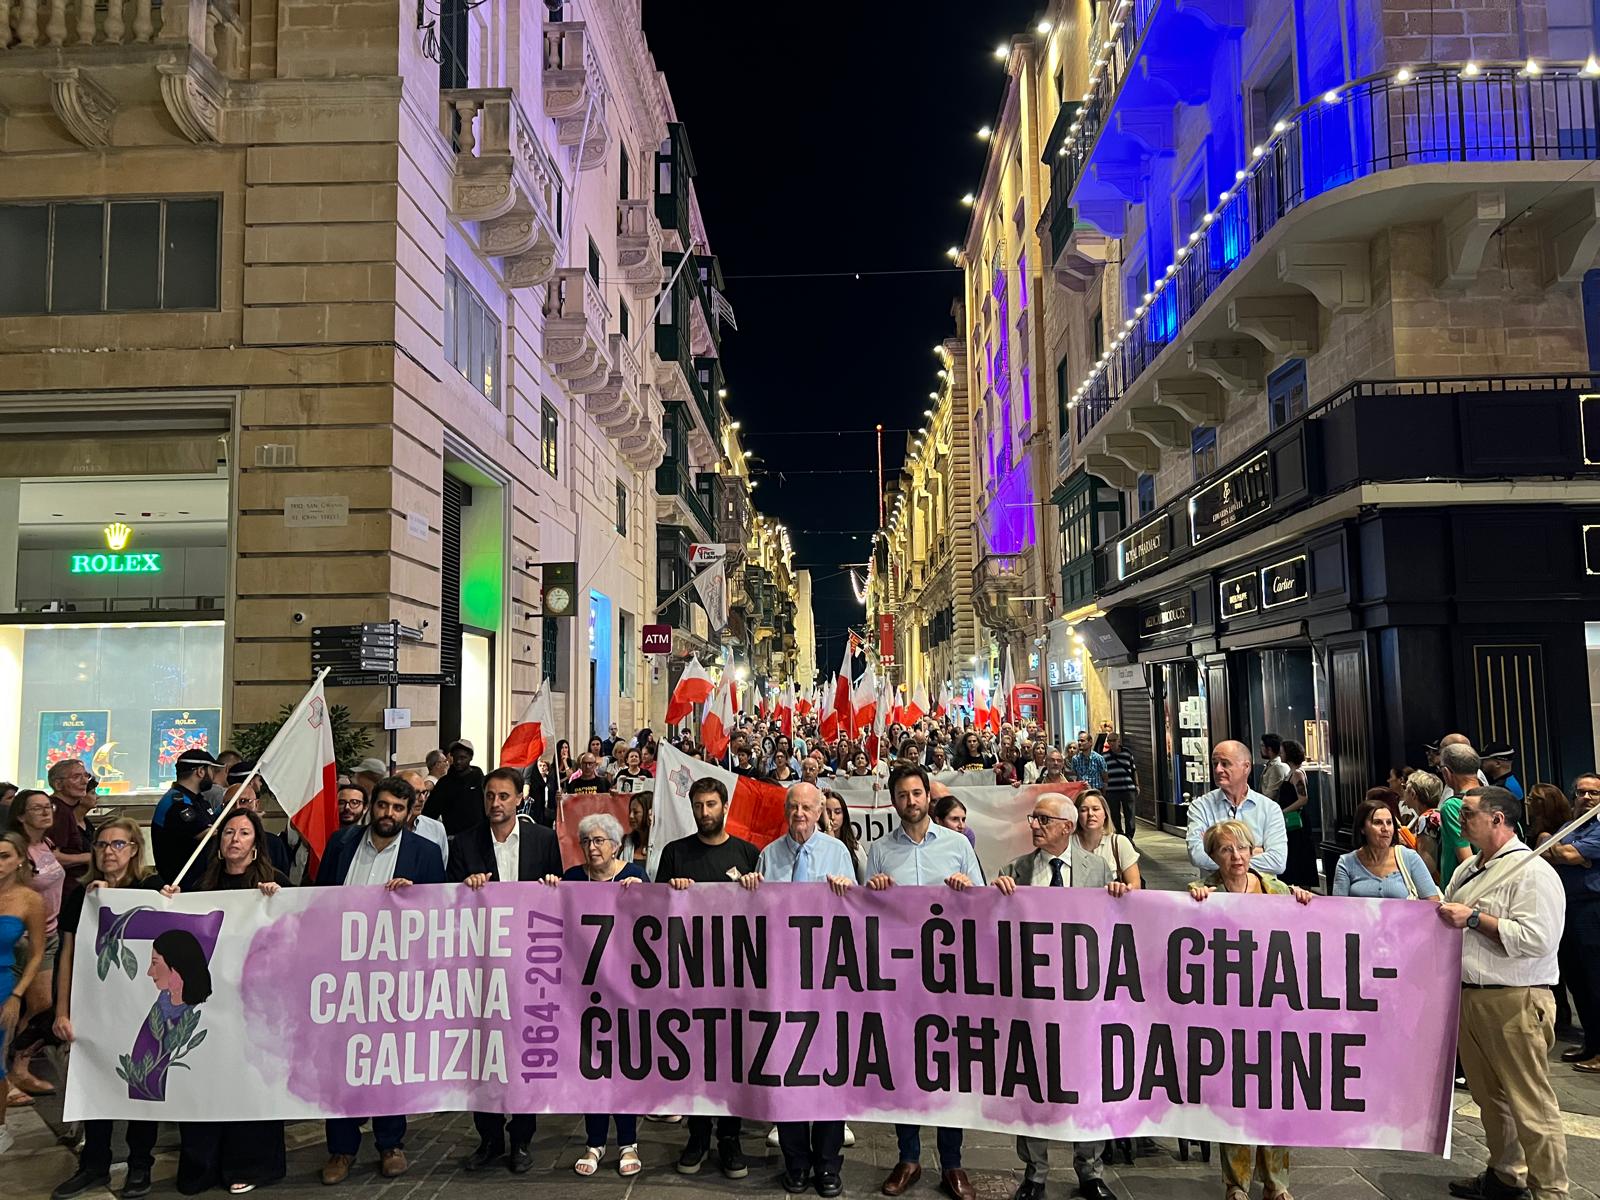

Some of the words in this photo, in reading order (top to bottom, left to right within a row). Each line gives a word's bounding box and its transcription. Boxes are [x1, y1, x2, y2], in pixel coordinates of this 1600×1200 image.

[71, 553, 161, 574] ROLEX
[1273, 576, 1295, 594] Cartier
[644, 634, 669, 644] ATM
[174, 718, 197, 726] ROLEX
[341, 906, 514, 962] DAPHNE
[580, 914, 615, 986] 7
[630, 914, 768, 990] SNIN
[788, 903, 1146, 1003] TAL-ĠLIEDA
[1166, 926, 1398, 1012] GĦALL-
[309, 968, 512, 1025] CARUANA
[521, 910, 564, 1084] 1964-2017
[345, 1028, 509, 1087] GALIZIA
[579, 990, 896, 1091] ĠUSTIZZJA
[913, 1013, 1080, 1105] GĦAL
[1100, 1022, 1367, 1112] DAPHNE
